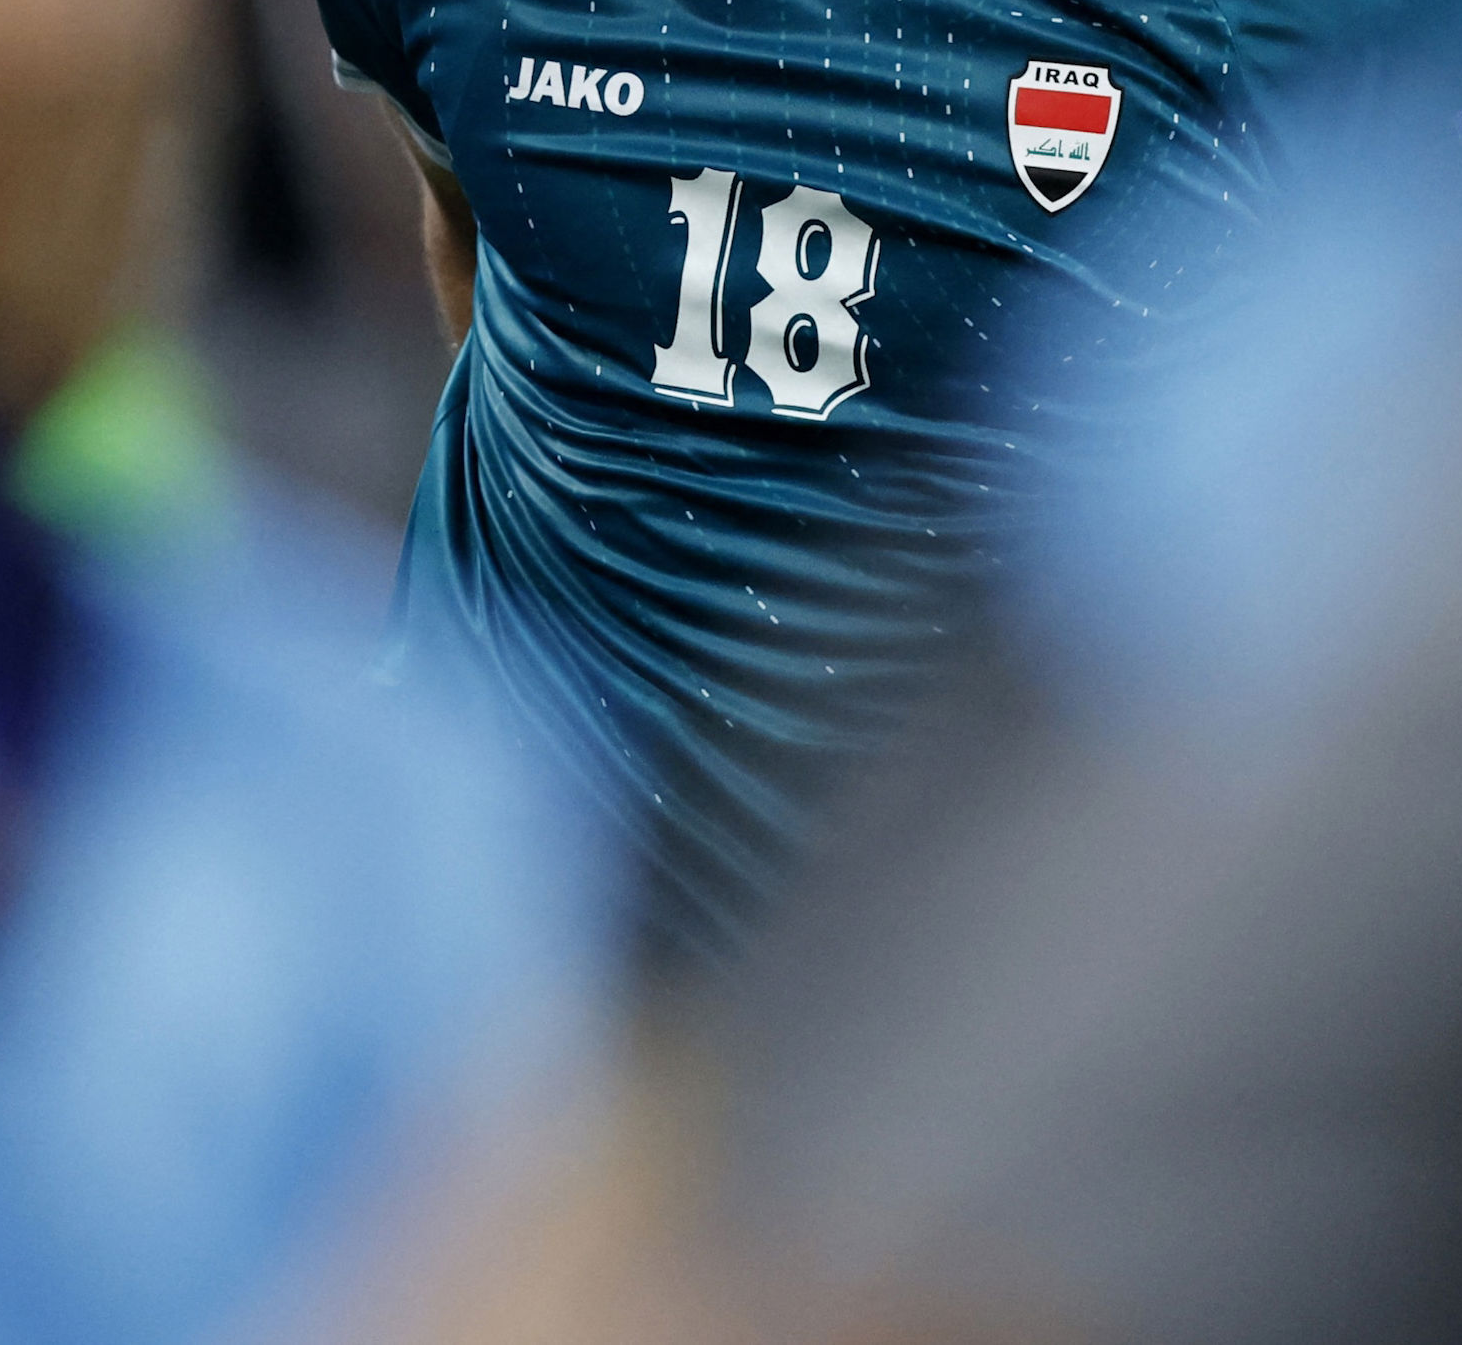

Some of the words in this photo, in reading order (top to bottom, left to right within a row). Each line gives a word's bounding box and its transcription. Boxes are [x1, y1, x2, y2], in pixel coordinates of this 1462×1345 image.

[508, 56, 645, 117] JAKO
[1035, 67, 1100, 89] IRAQ
[650, 166, 881, 421] 18
